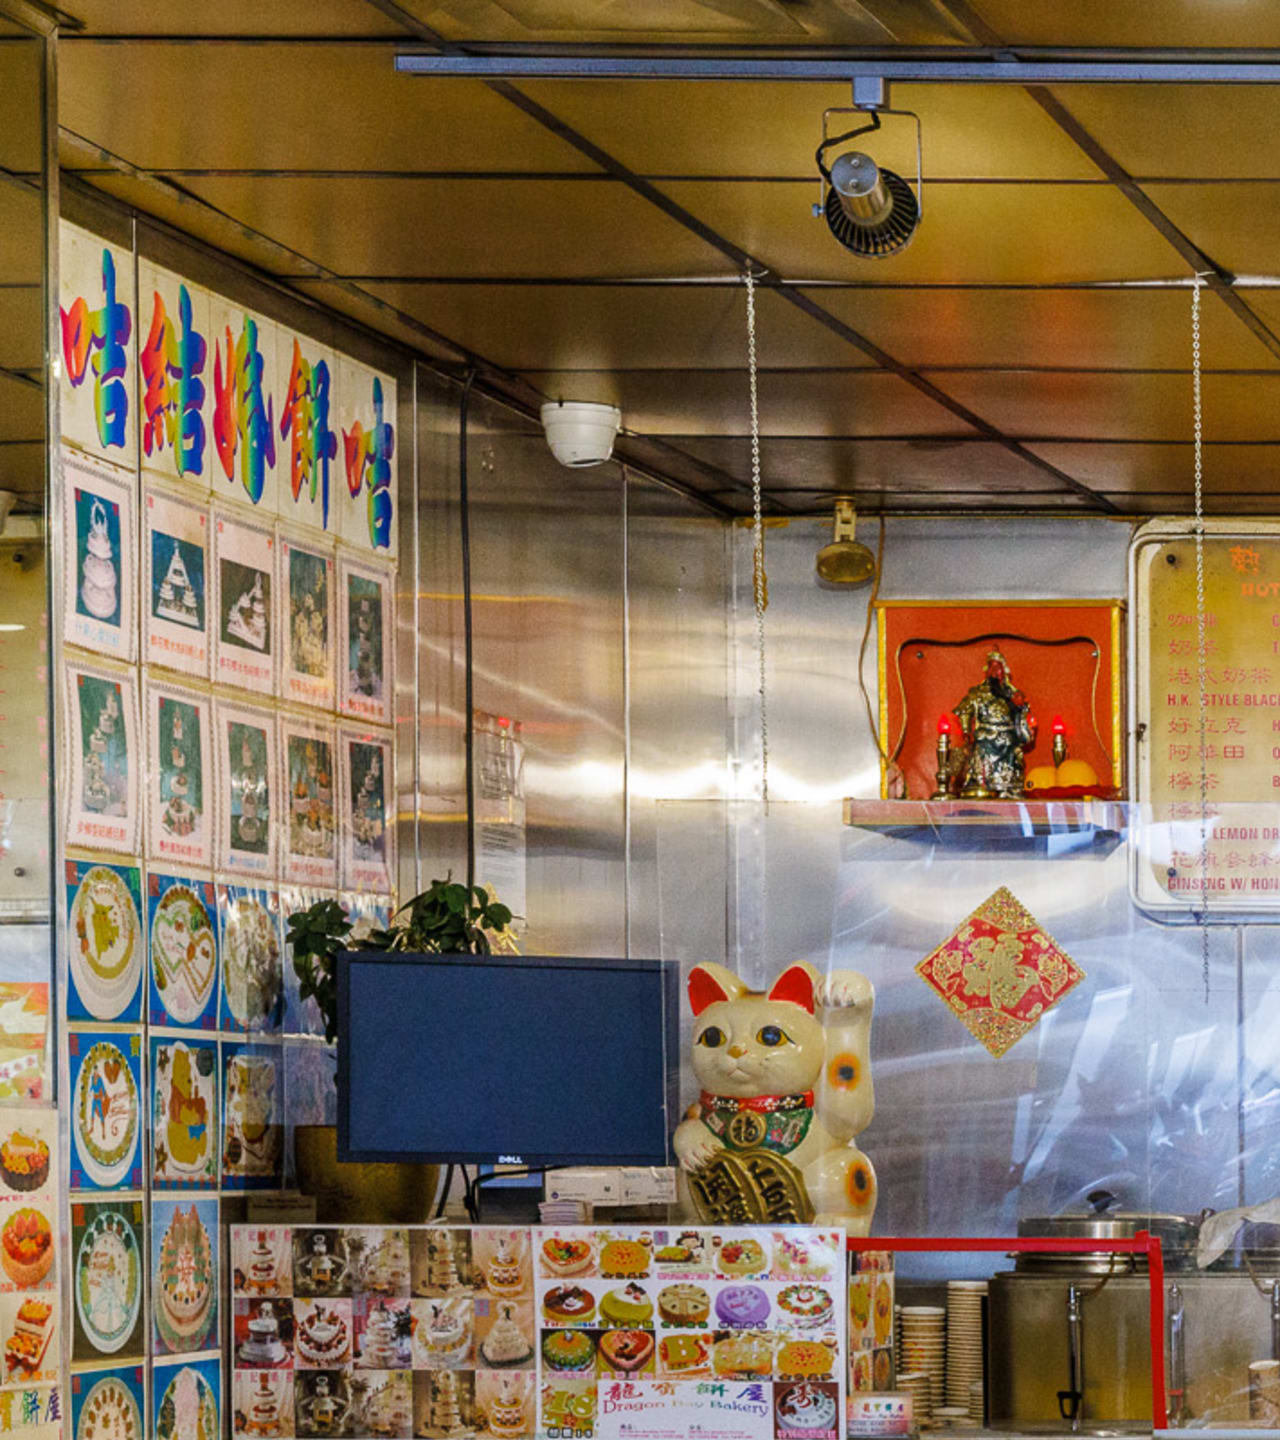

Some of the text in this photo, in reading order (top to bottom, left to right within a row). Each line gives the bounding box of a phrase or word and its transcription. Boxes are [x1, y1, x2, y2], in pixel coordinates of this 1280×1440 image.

[1241, 582, 1280, 598] HOT
[1201, 694, 1239, 707] STYLE
[1212, 827, 1258, 841] LEMON
[603, 1400, 769, 1417] Dragon Bakery
